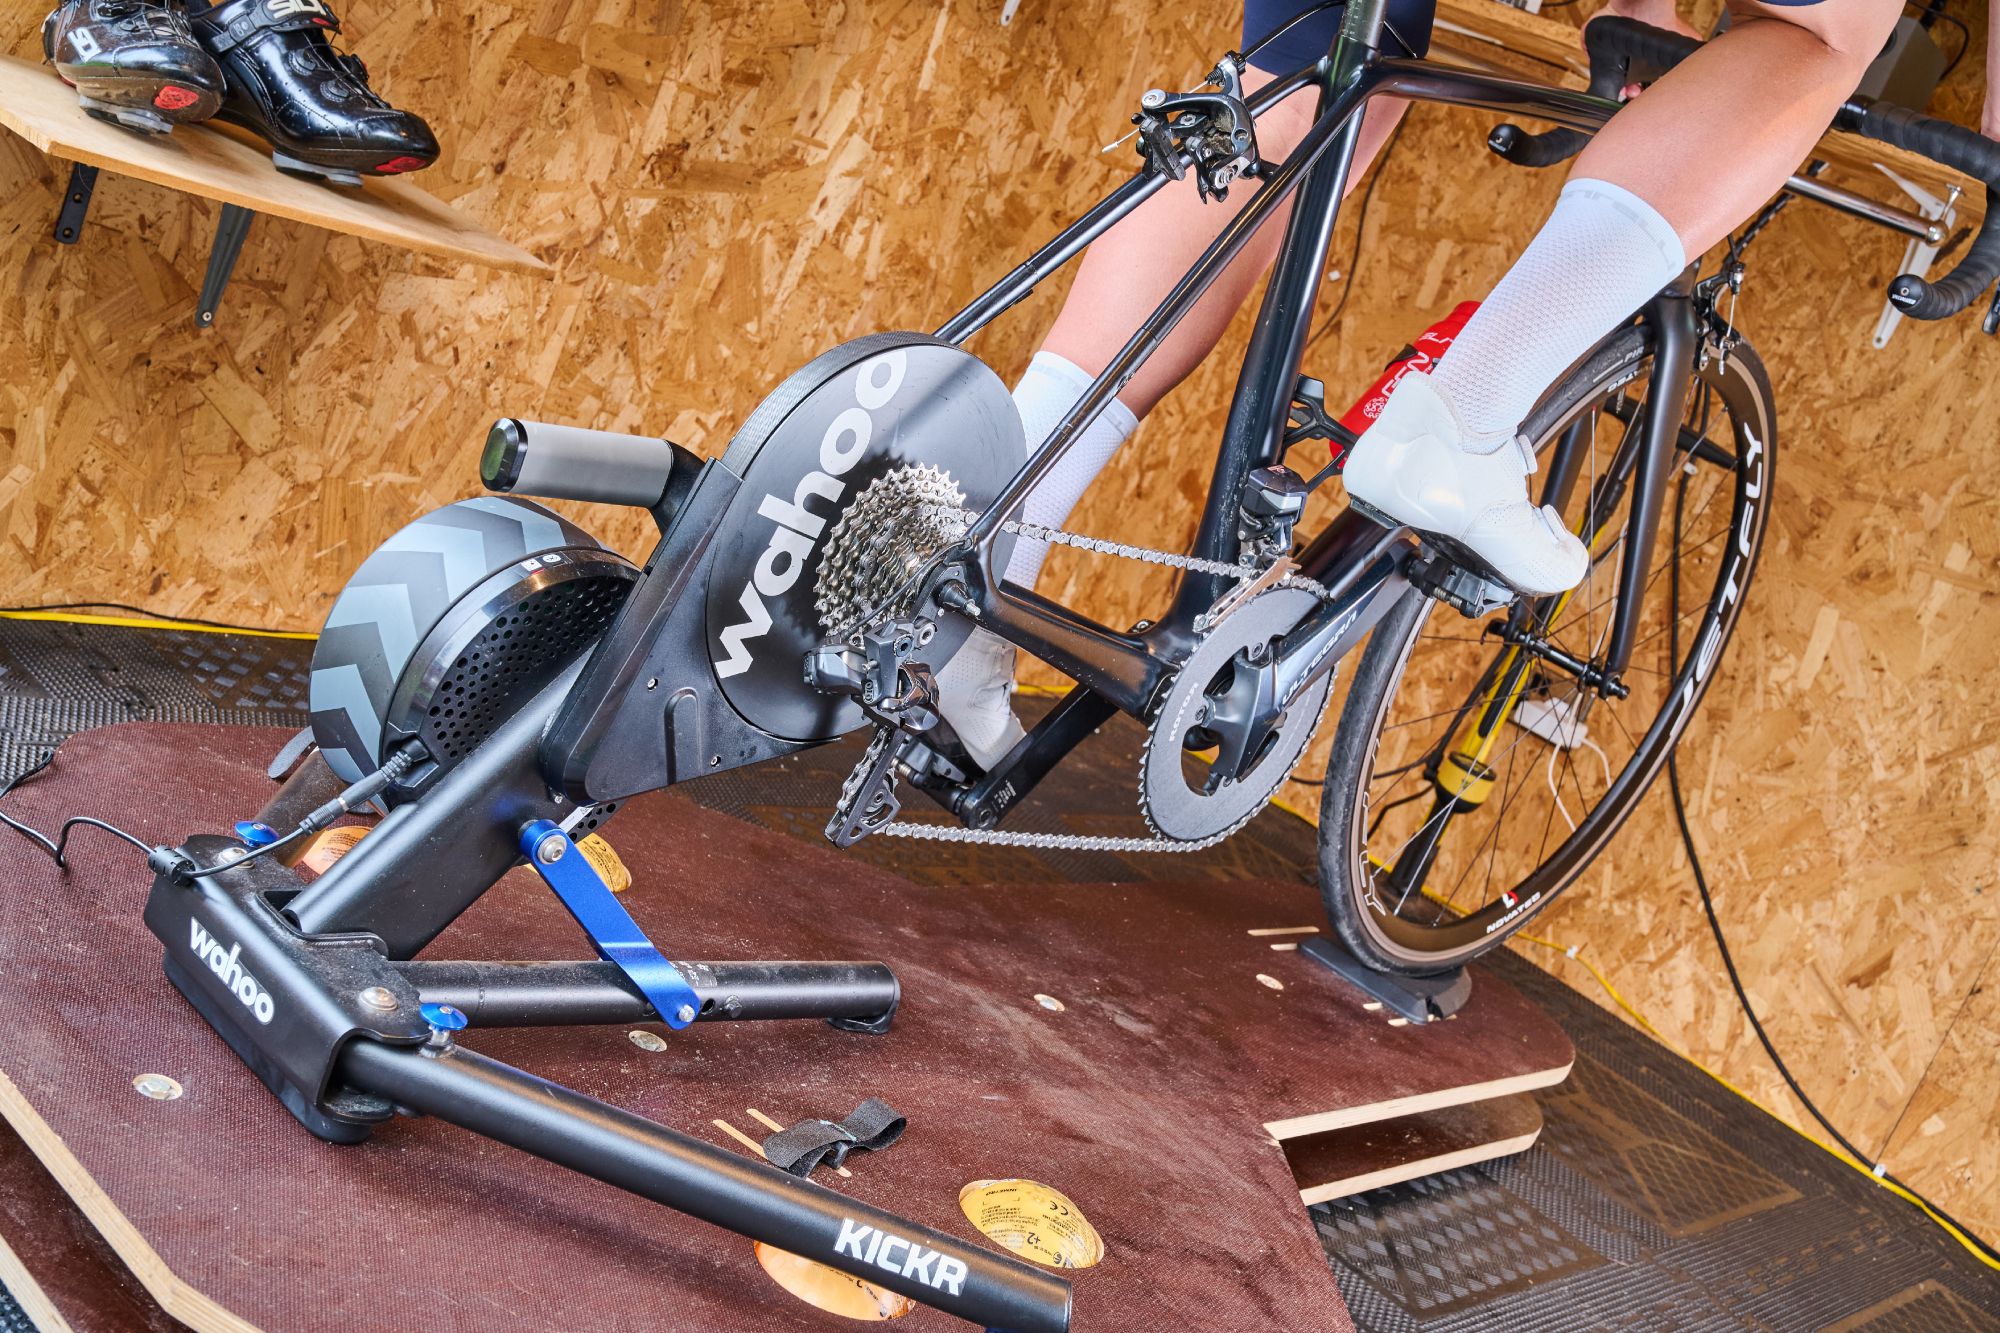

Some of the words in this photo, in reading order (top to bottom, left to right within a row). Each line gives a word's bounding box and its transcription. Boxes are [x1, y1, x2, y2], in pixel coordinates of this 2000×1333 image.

[714, 349, 907, 679] wahoo
[1668, 421, 1763, 739] JETFLY
[1282, 610, 1357, 704] ULTEGRA
[1486, 891, 1541, 934] NOVATEC
[190, 917, 275, 1024] wahoo
[834, 1217, 967, 1297] KICKR
